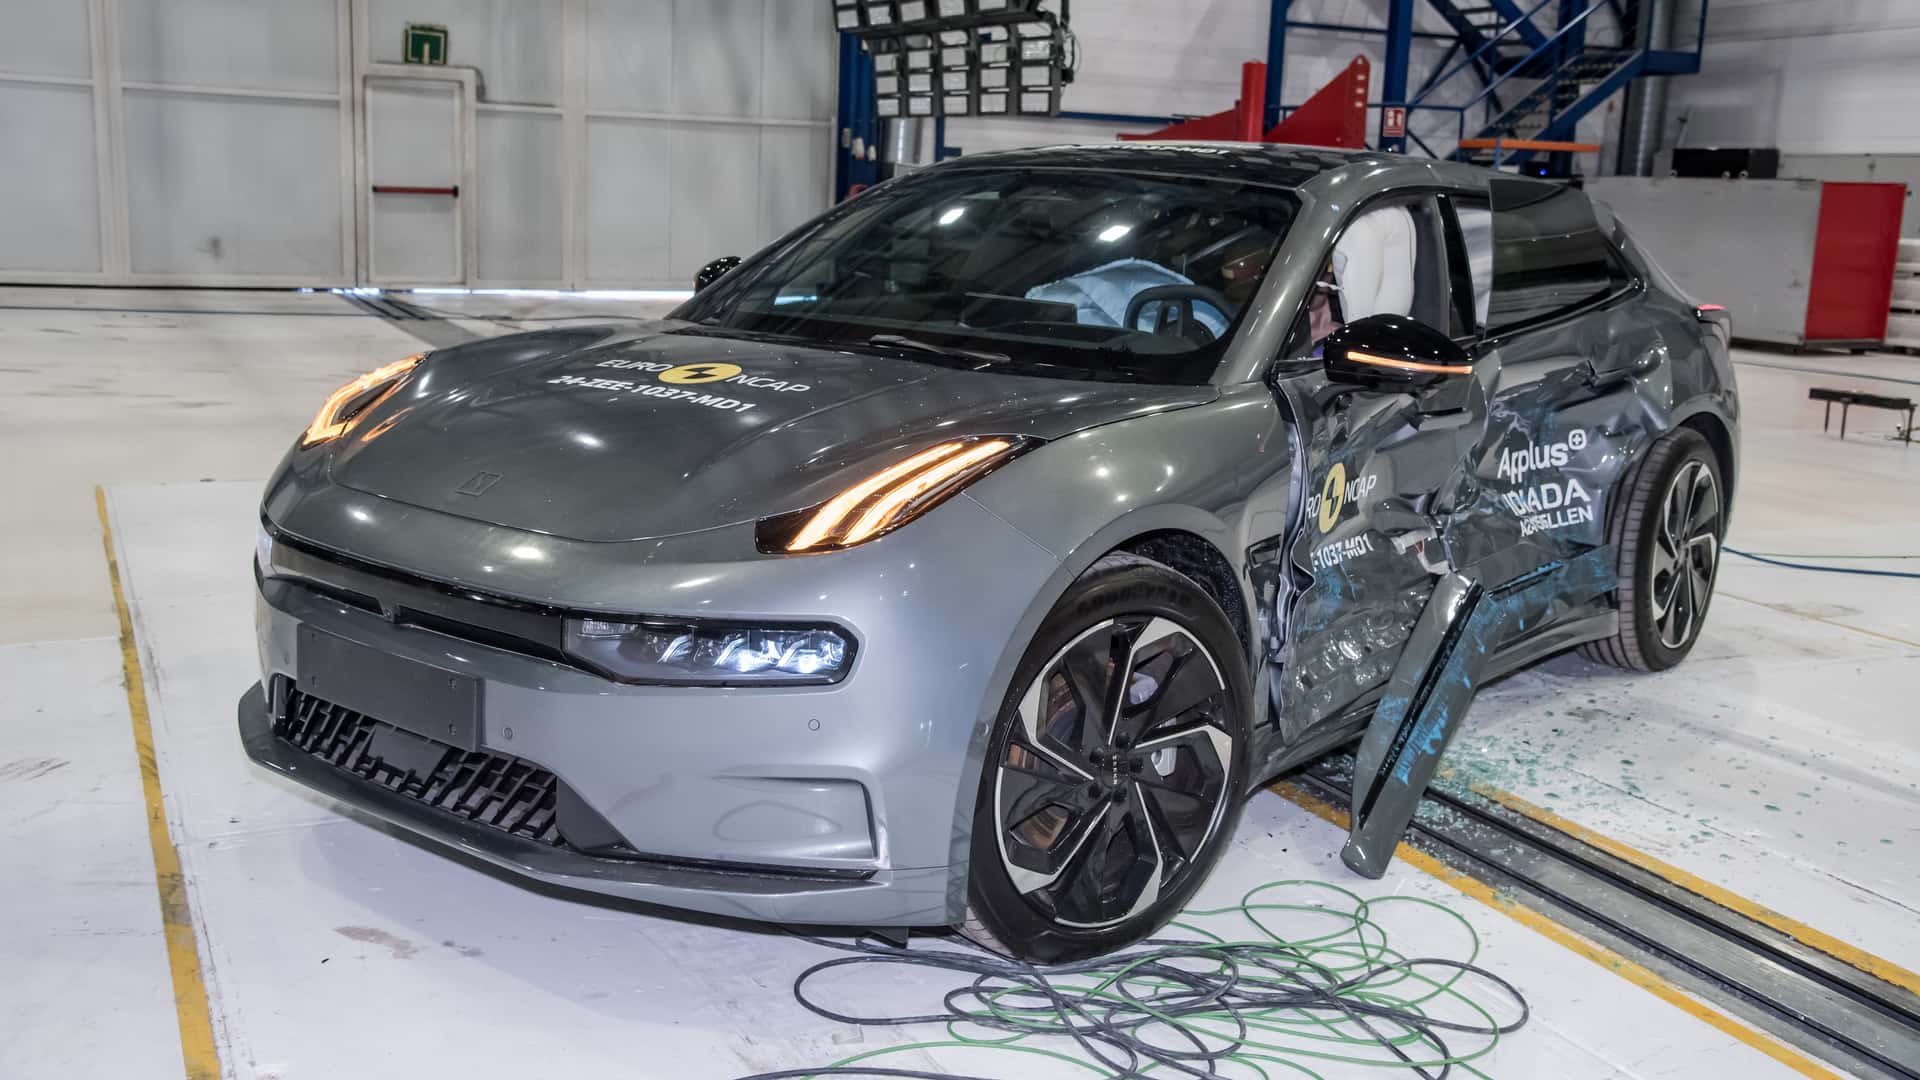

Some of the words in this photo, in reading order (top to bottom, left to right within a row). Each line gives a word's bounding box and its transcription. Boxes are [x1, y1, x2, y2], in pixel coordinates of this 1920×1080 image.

[595, 359, 674, 372] EURO
[725, 374, 811, 392] NCAP
[546, 375, 756, 412] 24-ZEE-1037-MD1
[1343, 474, 1377, 504] NCAP
